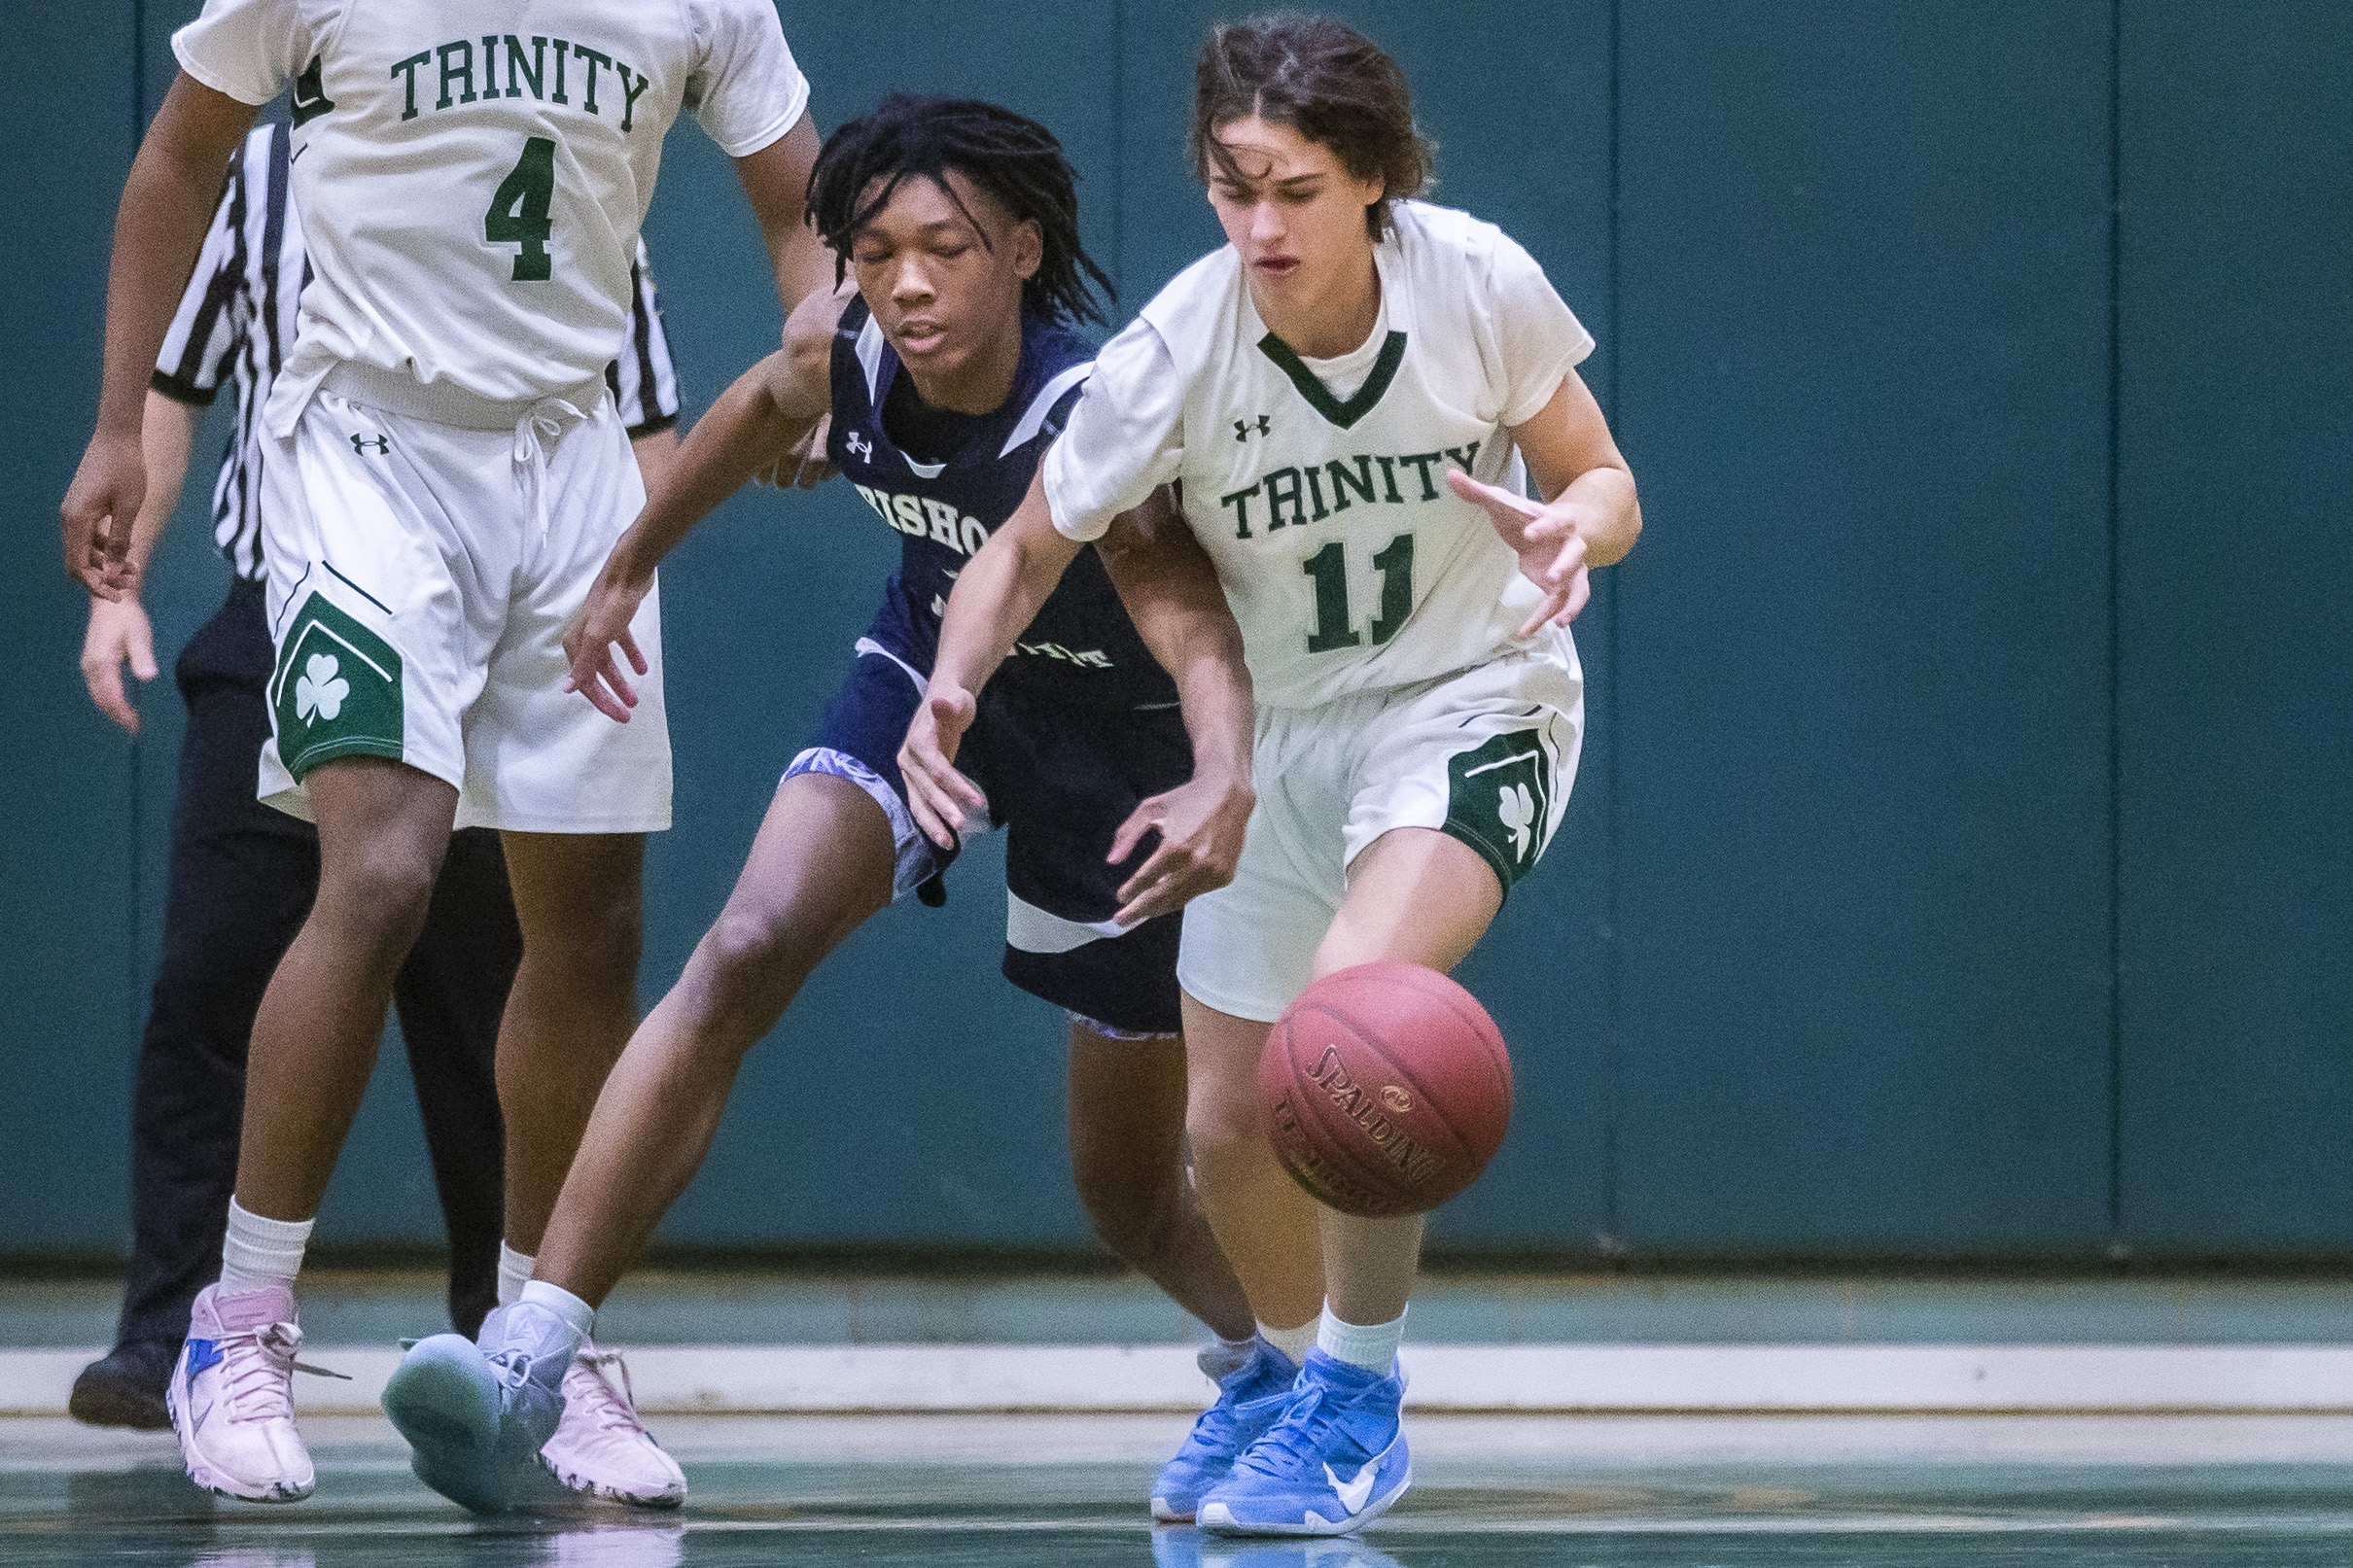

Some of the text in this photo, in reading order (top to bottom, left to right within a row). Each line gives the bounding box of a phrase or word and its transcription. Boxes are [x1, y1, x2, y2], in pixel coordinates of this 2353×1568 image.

[391, 34, 650, 133] TRINITY
[484, 136, 557, 282] 4
[1220, 440, 1481, 540] TRINITY
[1302, 533, 1415, 654] 11
[1304, 1043, 1441, 1185] SPALDING
